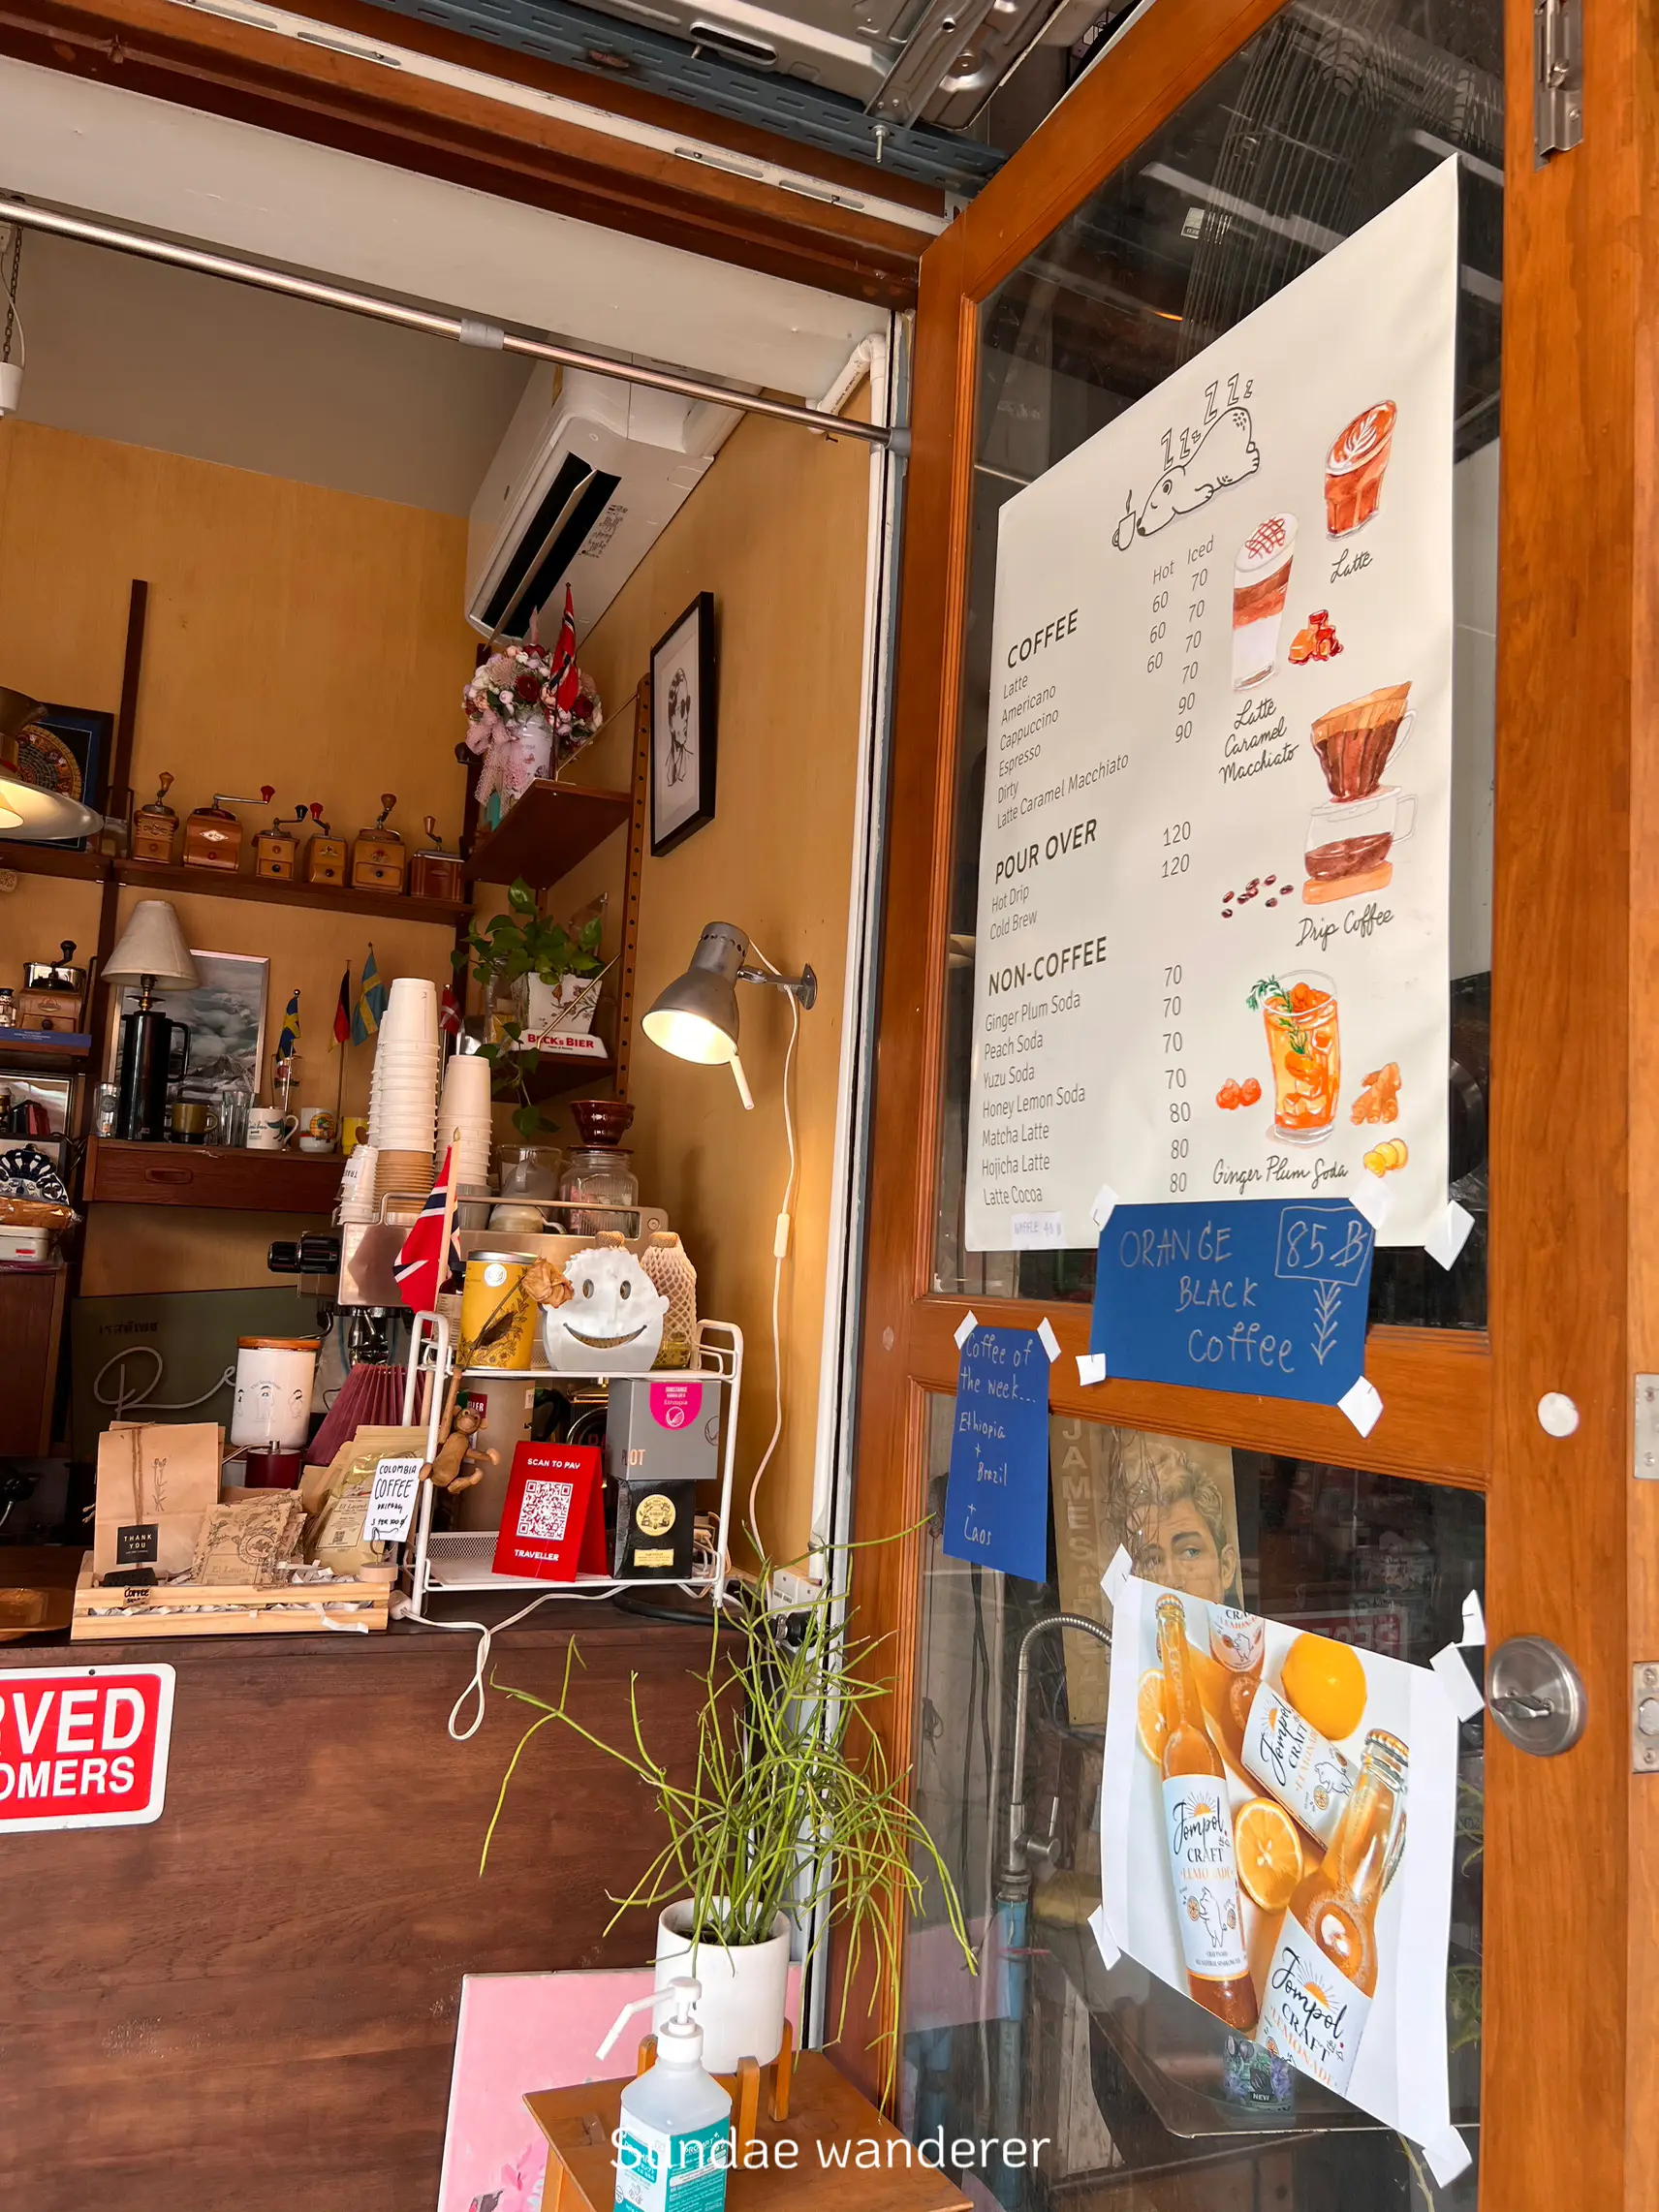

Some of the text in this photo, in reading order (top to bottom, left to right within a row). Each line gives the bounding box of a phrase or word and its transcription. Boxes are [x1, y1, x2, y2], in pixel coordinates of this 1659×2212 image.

[1152, 534, 1214, 585] Hot Iced
[1330, 548, 1374, 583] Latte
[1003, 568, 1208, 700] Latte 60 70
[1007, 608, 1079, 669] COFFEE
[1001, 599, 1205, 726] Americano 60 70
[999, 630, 1202, 751] Cappuccino 60 70
[998, 661, 1199, 778] Espresso 70
[1234, 698, 1277, 730] Latte
[997, 692, 1196, 804] Dirty 90
[1224, 716, 1288, 758] Caramel
[997, 720, 1193, 829] Latte Caramel Macchiato 90
[1218, 743, 1299, 784] Macchiato
[991, 821, 1191, 914] Hot Drip 120
[995, 818, 1097, 885] POUR OVER
[989, 853, 1190, 941] Cold Brew 120
[1295, 902, 1394, 951] Drip Coffee
[988, 935, 1107, 997] NON-COFFEE
[985, 964, 1182, 1033] Ginger Plum Soda 70
[566, 1037, 594, 1048] BIER
[984, 995, 1181, 1061] Peach Soda 70
[983, 1031, 1183, 1089] Yuzu Soda 70
[982, 1068, 1186, 1120] Honey Lemon Soda 70
[982, 1102, 1191, 1148] Matcha Latte 80
[982, 1137, 1189, 1180] Hojicha Latte 80
[1212, 1155, 1349, 1195] Ginger Plum Soda
[983, 1171, 1187, 1206] Latte Cocoa 80
[1119, 1220, 1234, 1268] ORANGE
[1286, 1220, 1328, 1269] 85
[1175, 1275, 1259, 1313] BLACK
[965, 1332, 1033, 1367] Coffee of
[1188, 1322, 1295, 1373] Coffee
[959, 1365, 981, 1393] the
[958, 1411, 1007, 1440] Ethiopia
[379, 1464, 418, 1475] COLOMBIA
[527, 1457, 550, 1468] SCAN
[551, 1459, 563, 1469] TO
[976, 1461, 1008, 1486] Brazil
[374, 1478, 415, 1500] COFFEE
[123, 1533, 153, 1542] THANK
[963, 1515, 992, 1546] Laos
[514, 1548, 560, 1562] TRAVELLER
[0, 1687, 145, 1757] VED
[1181, 1867, 1233, 1881] LEMOADE
[1187, 1847, 1224, 1863] CRAFT
[1282, 2003, 1330, 2063] CRAFT
[1252, 2092, 1271, 2102] NEW
